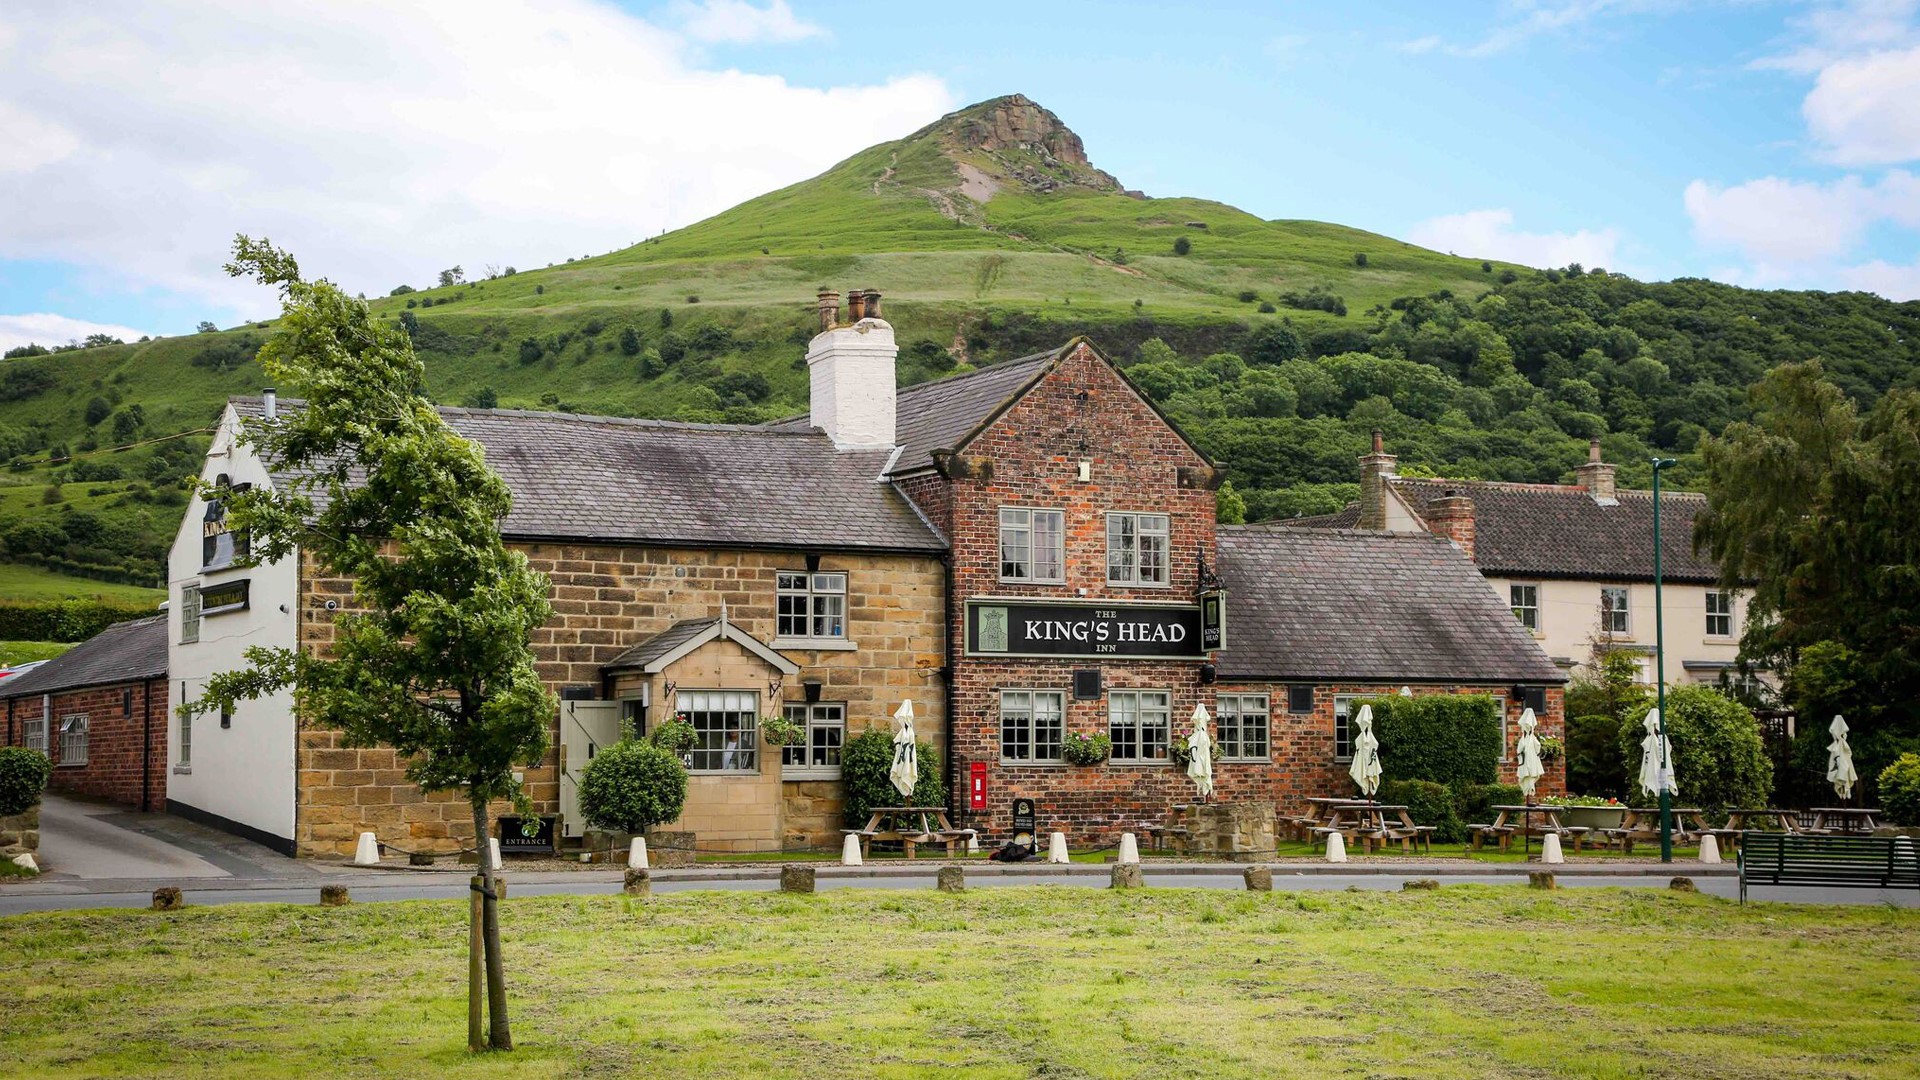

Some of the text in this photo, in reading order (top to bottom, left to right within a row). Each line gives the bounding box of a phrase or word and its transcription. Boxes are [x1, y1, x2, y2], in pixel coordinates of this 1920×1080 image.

[1095, 610, 1117, 619] THE
[1024, 620, 1186, 643] KING'S HEAD
[1205, 634, 1219, 642] HEAD
[1095, 644, 1117, 652] INN
